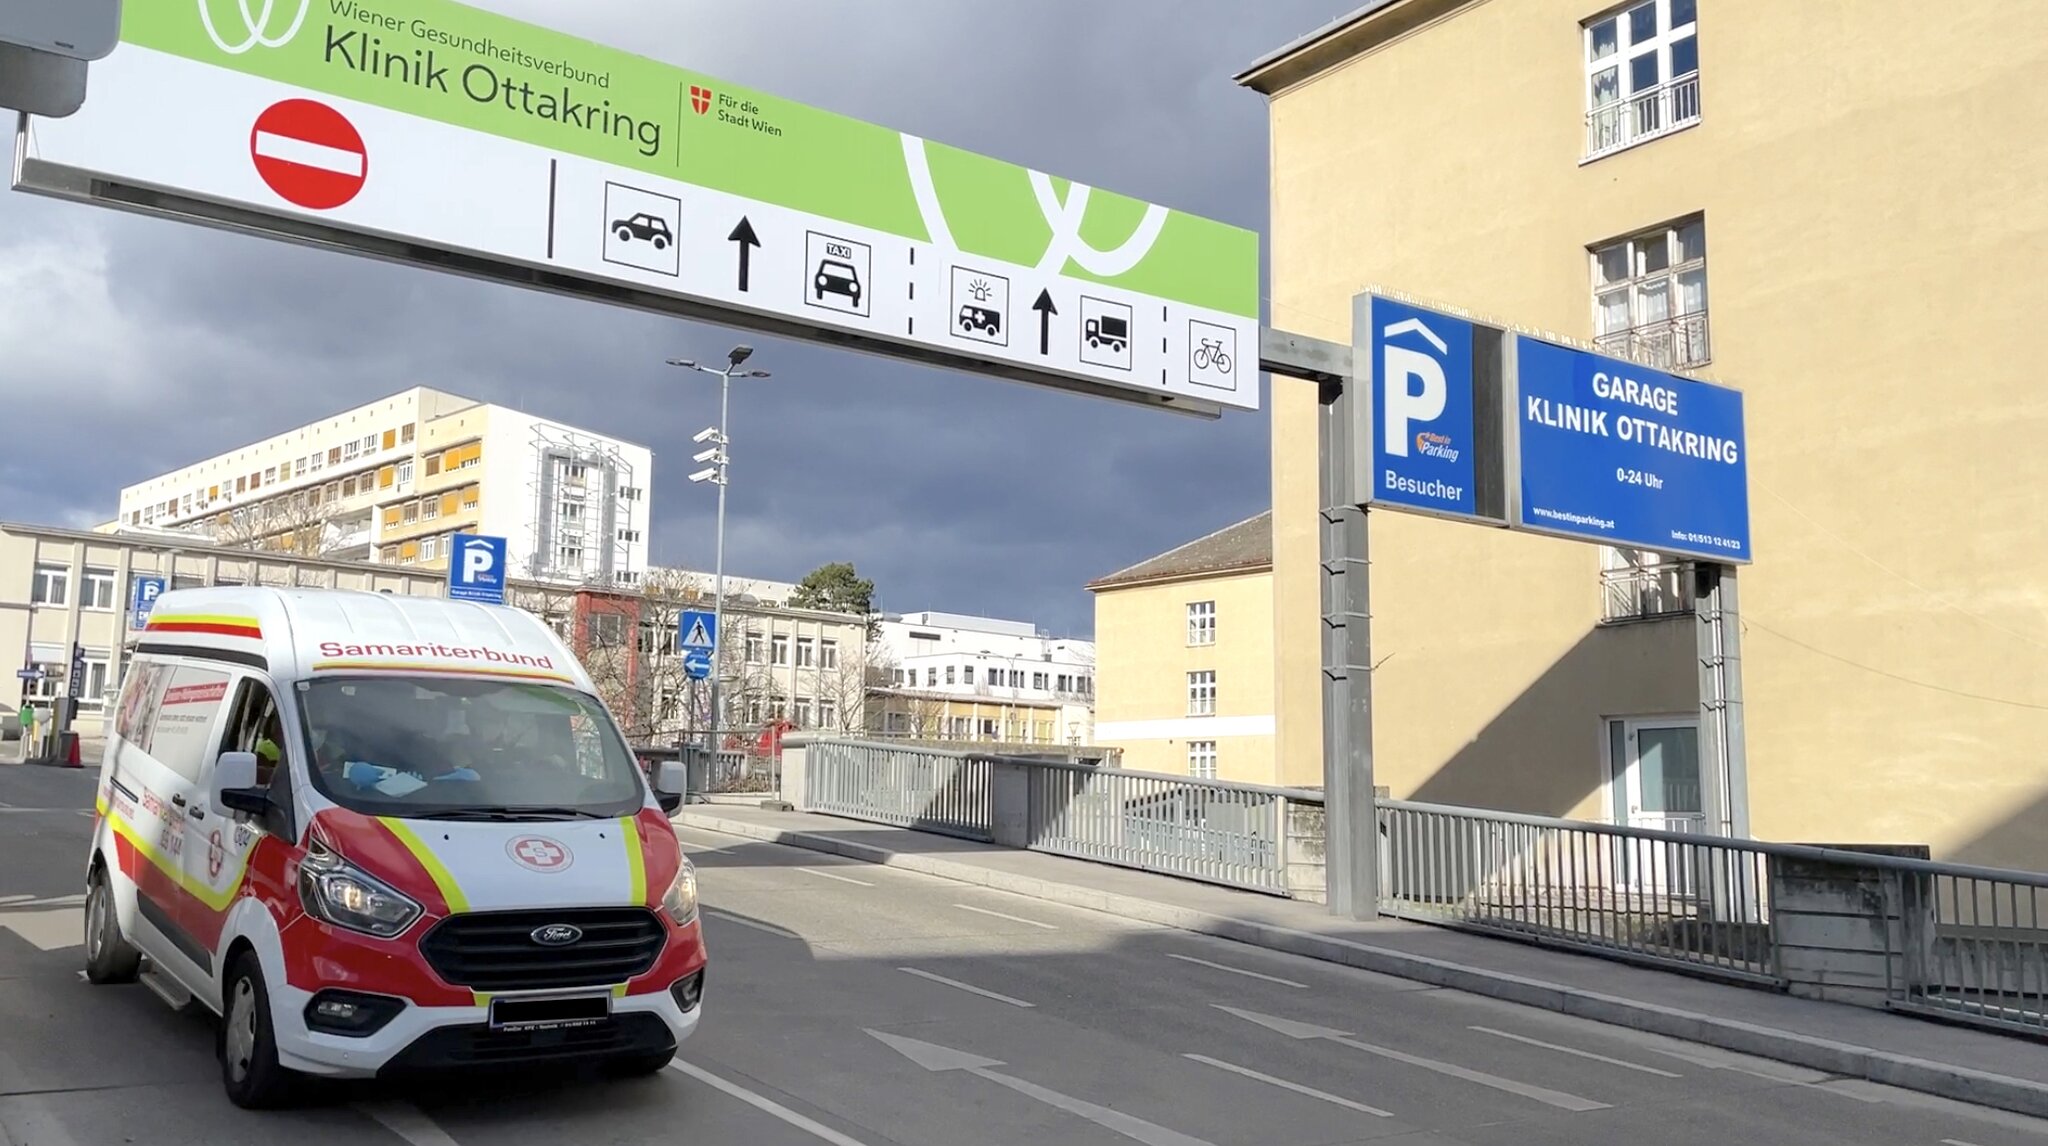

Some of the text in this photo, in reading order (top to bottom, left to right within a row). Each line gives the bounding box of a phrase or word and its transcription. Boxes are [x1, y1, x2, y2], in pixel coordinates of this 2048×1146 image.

[328, 0, 610, 89] Wiener Gesundheitsverbund
[324, 24, 662, 157] Klinik Ottakring
[718, 93, 759, 115] Für die
[717, 109, 782, 137] Stadt Wien
[827, 243, 851, 259] TAXI
[1384, 344, 1447, 457] P
[1592, 372, 1679, 416] GARAGE
[1527, 395, 1738, 465] KLINIK OTTAKRING
[1420, 441, 1460, 463] Parking
[1385, 469, 1463, 501] Besucher
[1616, 467, 1664, 490] 0-24 Uhr
[1532, 506, 1615, 529] www.bestinparking.at
[463, 548, 494, 584] P
[319, 641, 554, 670] Samariterbund
[543, 927, 573, 941] Ford
